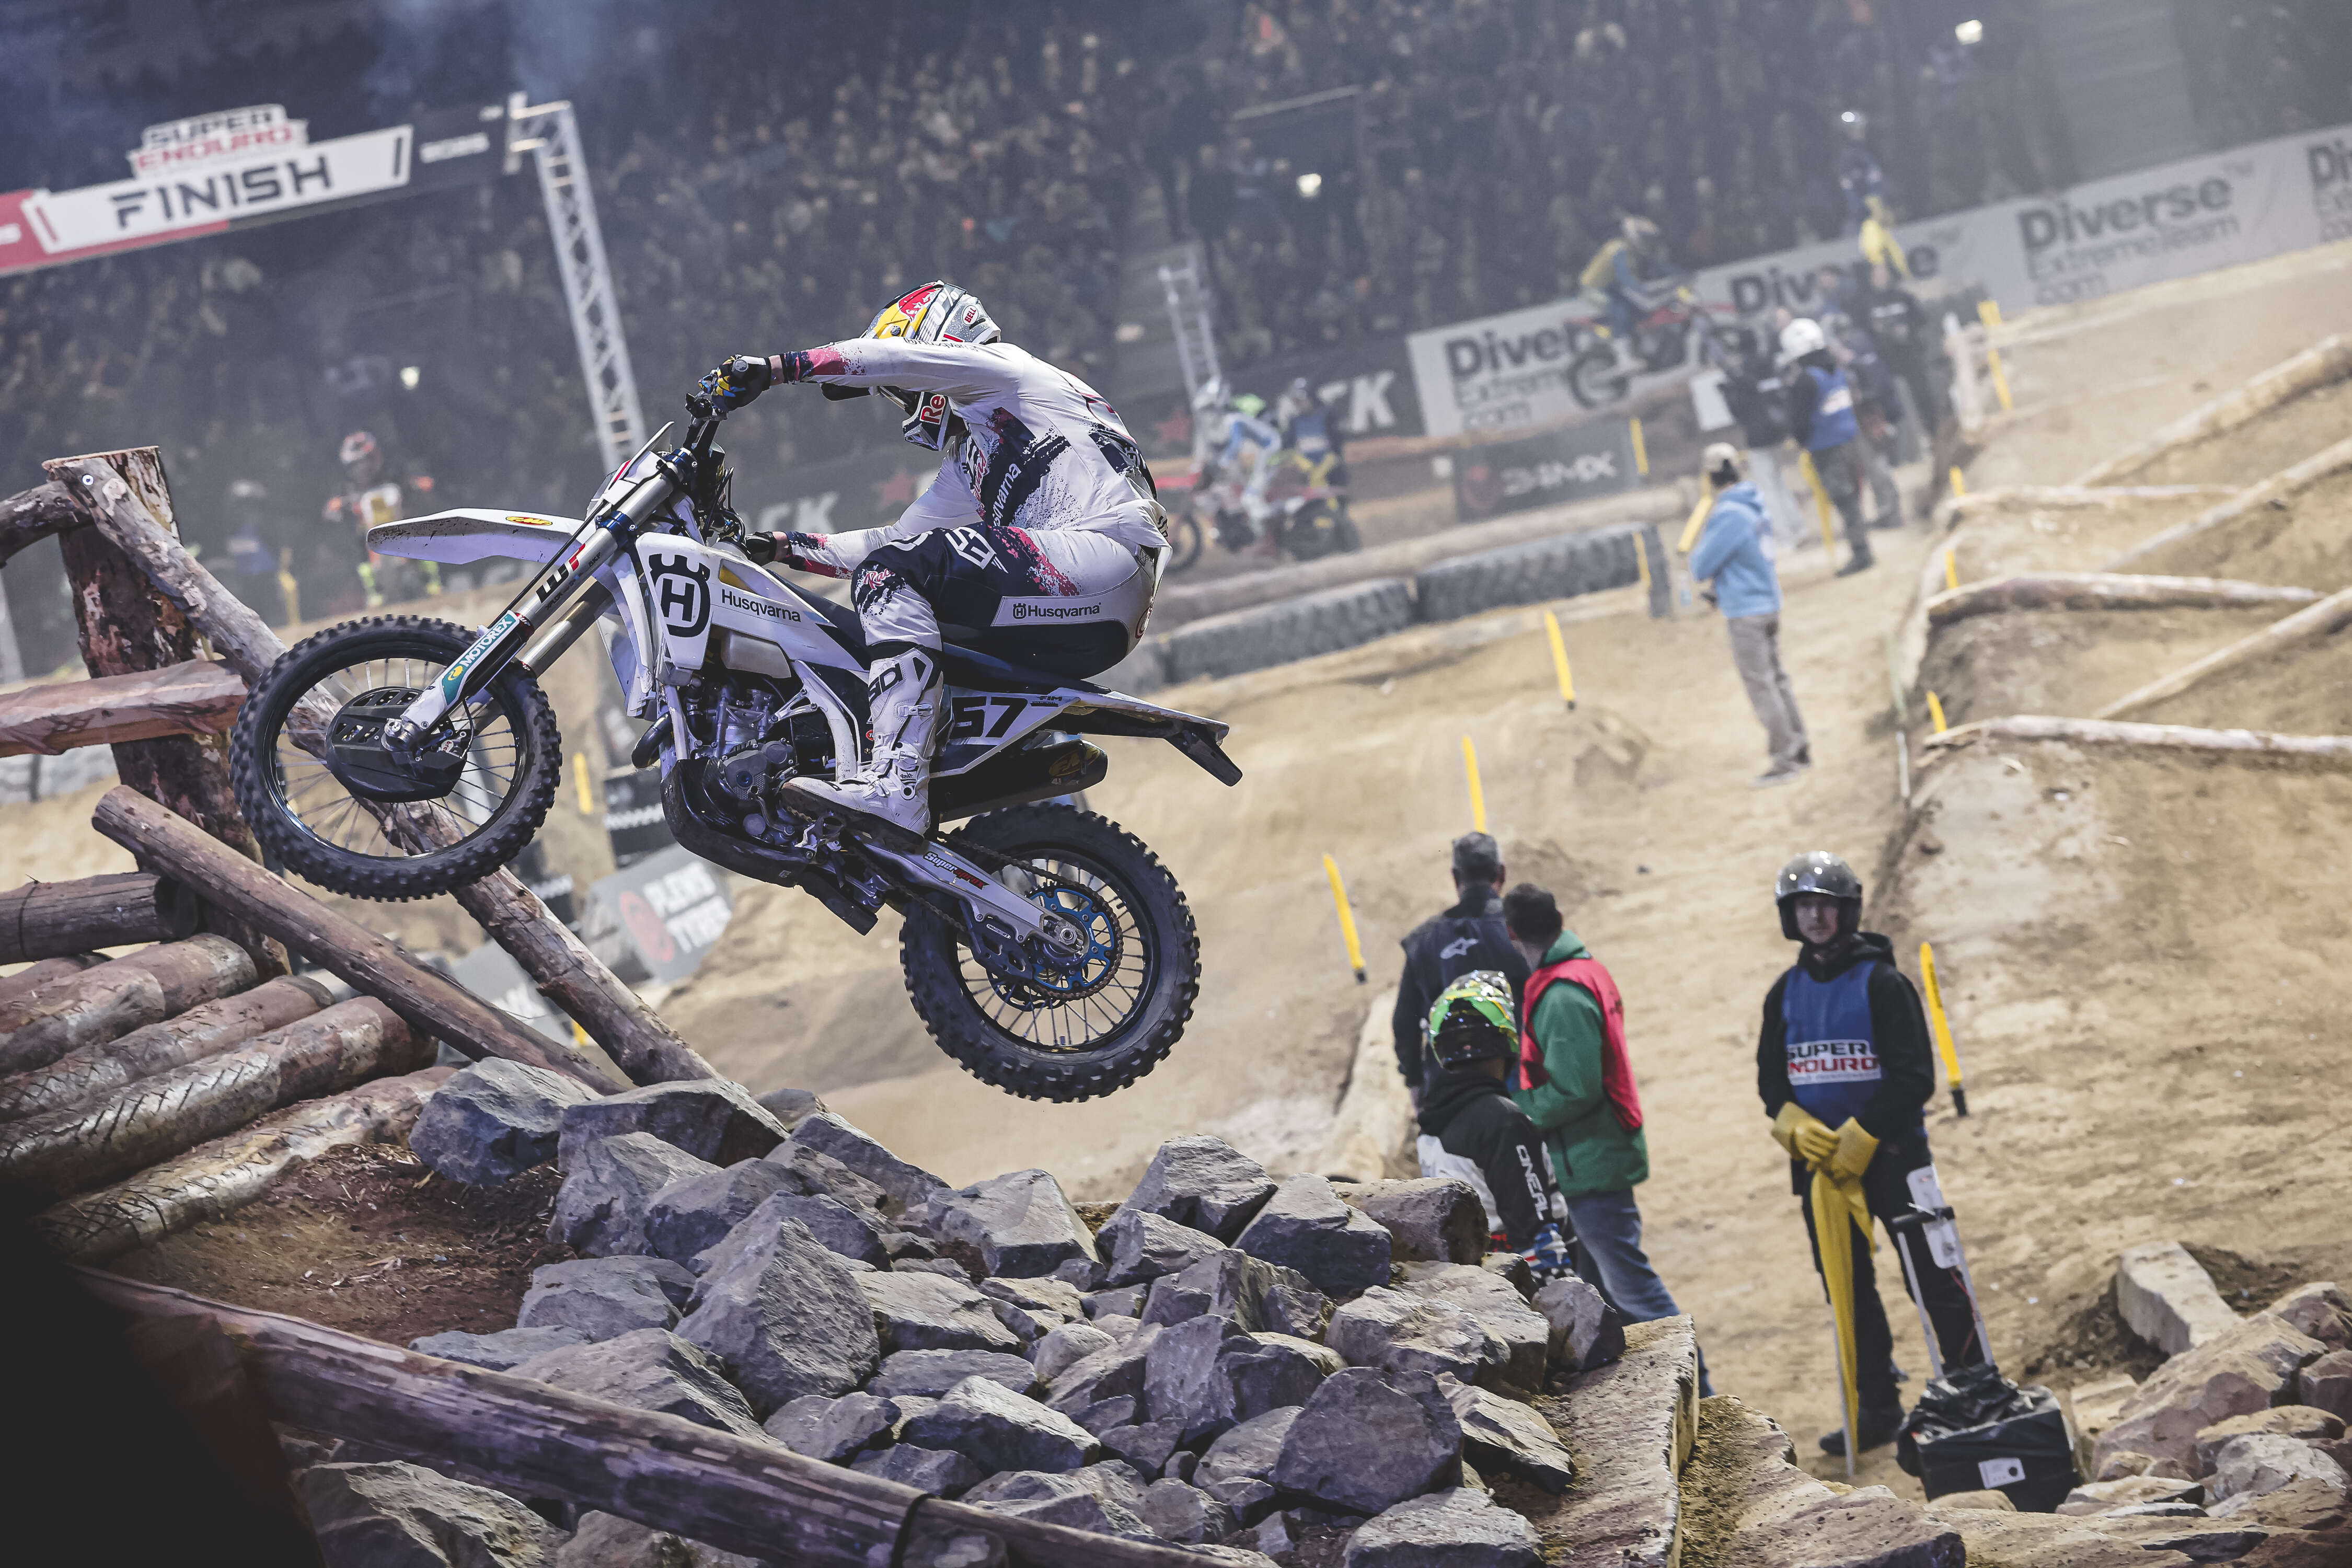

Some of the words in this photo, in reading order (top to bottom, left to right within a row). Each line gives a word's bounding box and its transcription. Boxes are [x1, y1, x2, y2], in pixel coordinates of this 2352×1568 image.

[137, 127, 293, 168] ENDURO
[111, 155, 332, 229] FINISH
[2017, 178, 2233, 251] Diverse
[964, 307, 977, 324] BELL
[920, 394, 946, 425] Re
[721, 589, 801, 622] Husqvarna
[1028, 604, 1100, 619] Husqvarna
[459, 618, 513, 667] MOTOREX
[952, 696, 1029, 738] 57
[1788, 1042, 1866, 1060] SUPER
[1789, 1057, 1879, 1073] NDURO
